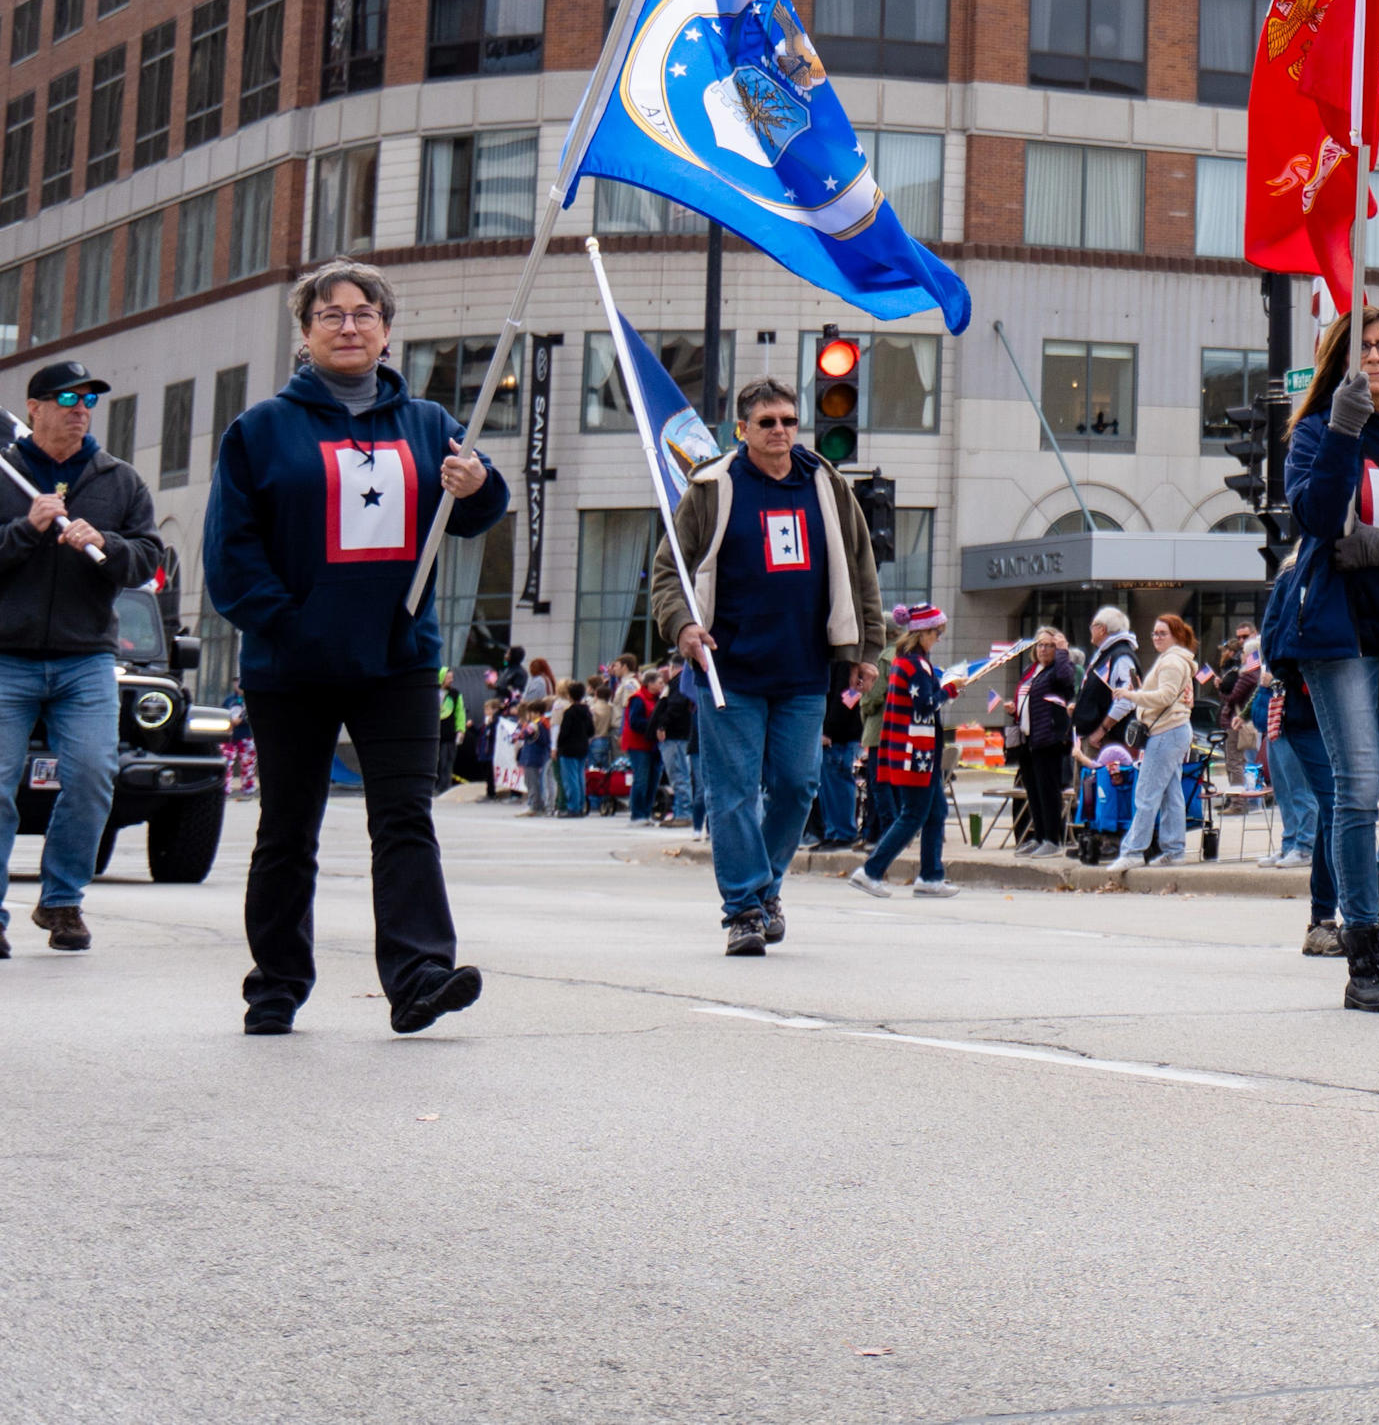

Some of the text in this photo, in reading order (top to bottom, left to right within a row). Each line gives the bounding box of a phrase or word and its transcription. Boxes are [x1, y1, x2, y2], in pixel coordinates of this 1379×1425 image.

[531, 394, 547, 475] SAINT
[987, 553, 1064, 579] SAINT KATE
